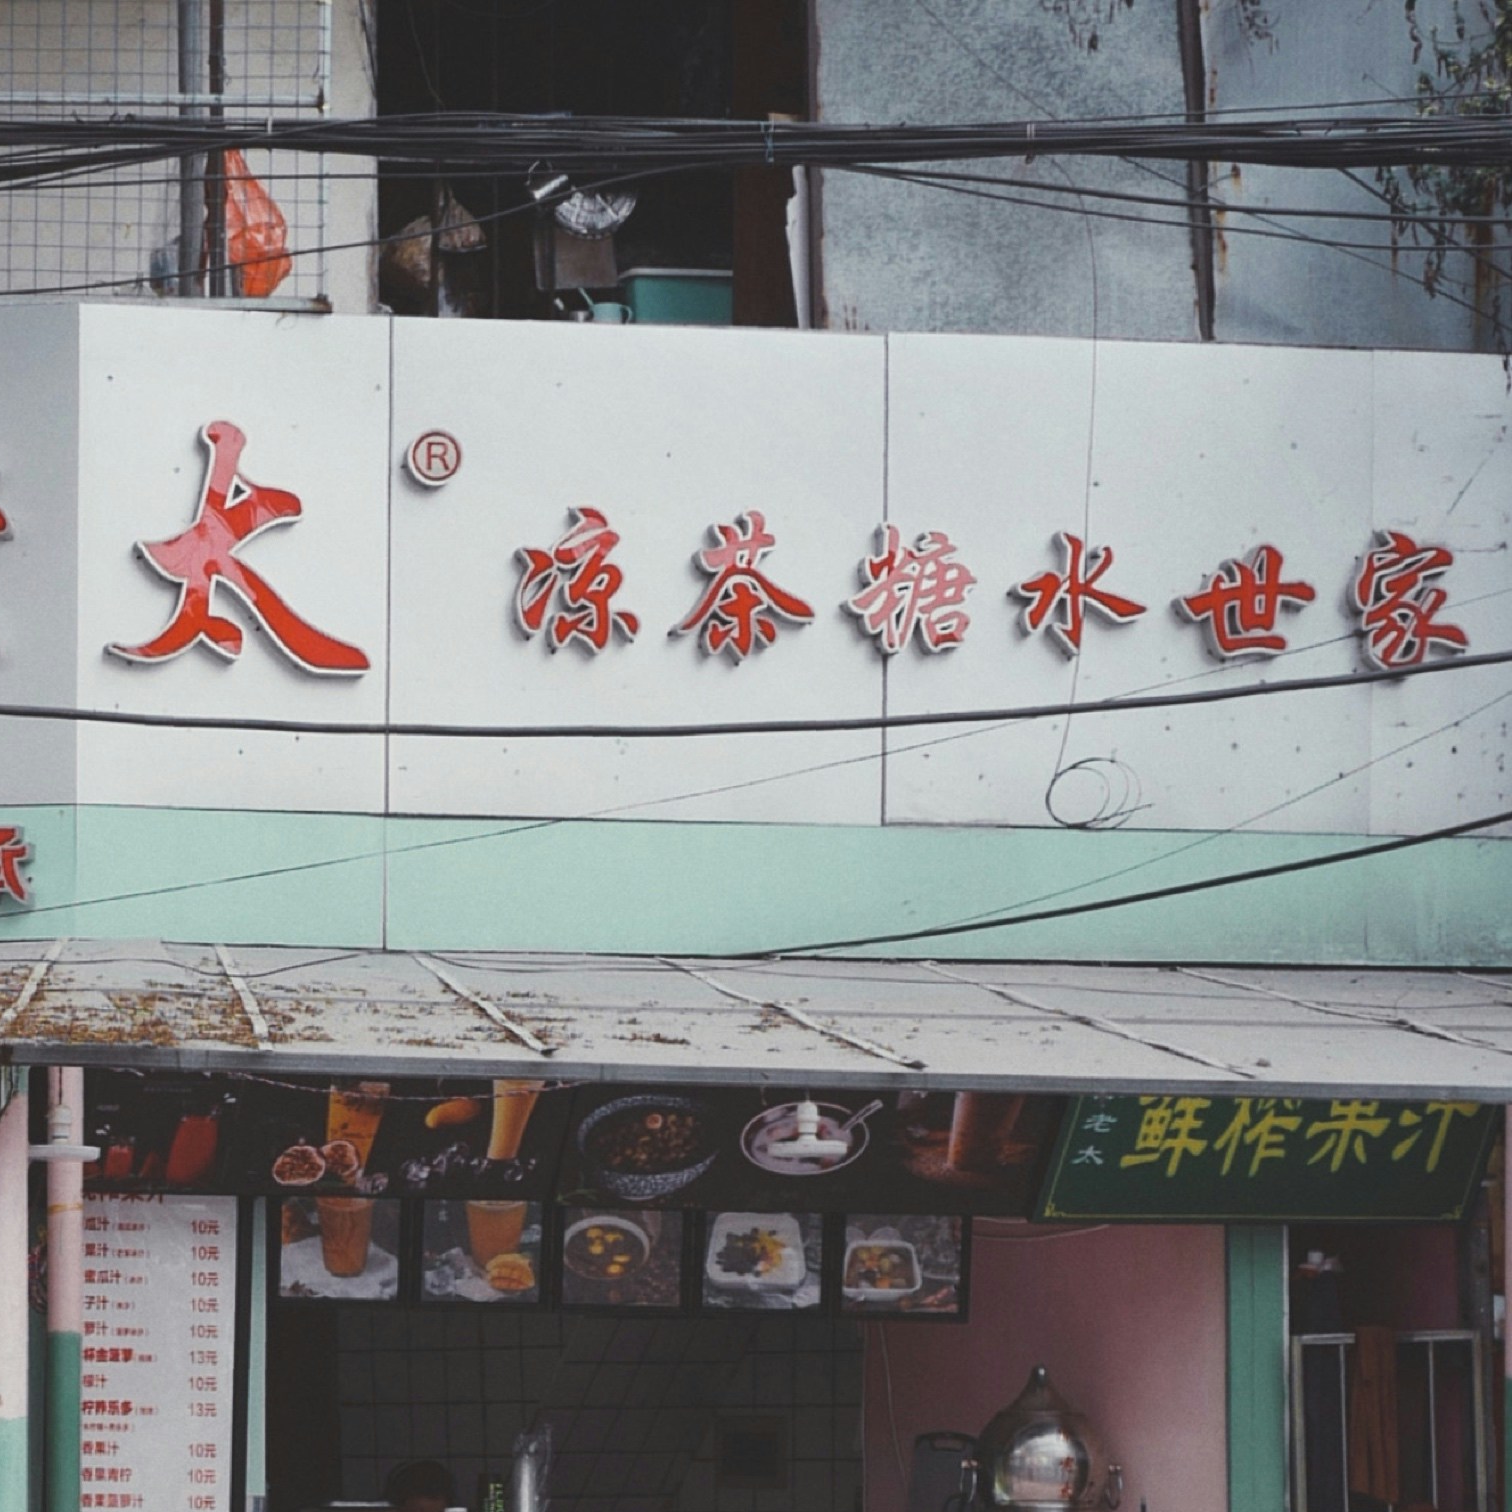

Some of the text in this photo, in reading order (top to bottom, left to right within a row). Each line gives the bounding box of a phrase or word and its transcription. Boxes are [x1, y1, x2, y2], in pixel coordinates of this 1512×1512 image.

[517, 506, 1469, 670] 凉茶糖水世家
[191, 1220, 219, 1235] 10元
[191, 1246, 219, 1260] 10元
[191, 1272, 218, 1286] 10元
[190, 1298, 218, 1313] 10元
[190, 1324, 218, 1339] 10元
[189, 1351, 217, 1366] 13元
[189, 1377, 217, 1392] 10元
[189, 1403, 217, 1417] 13元
[189, 1443, 216, 1458] 10元
[189, 1469, 216, 1484] 10元
[188, 1496, 216, 1510] 10元
